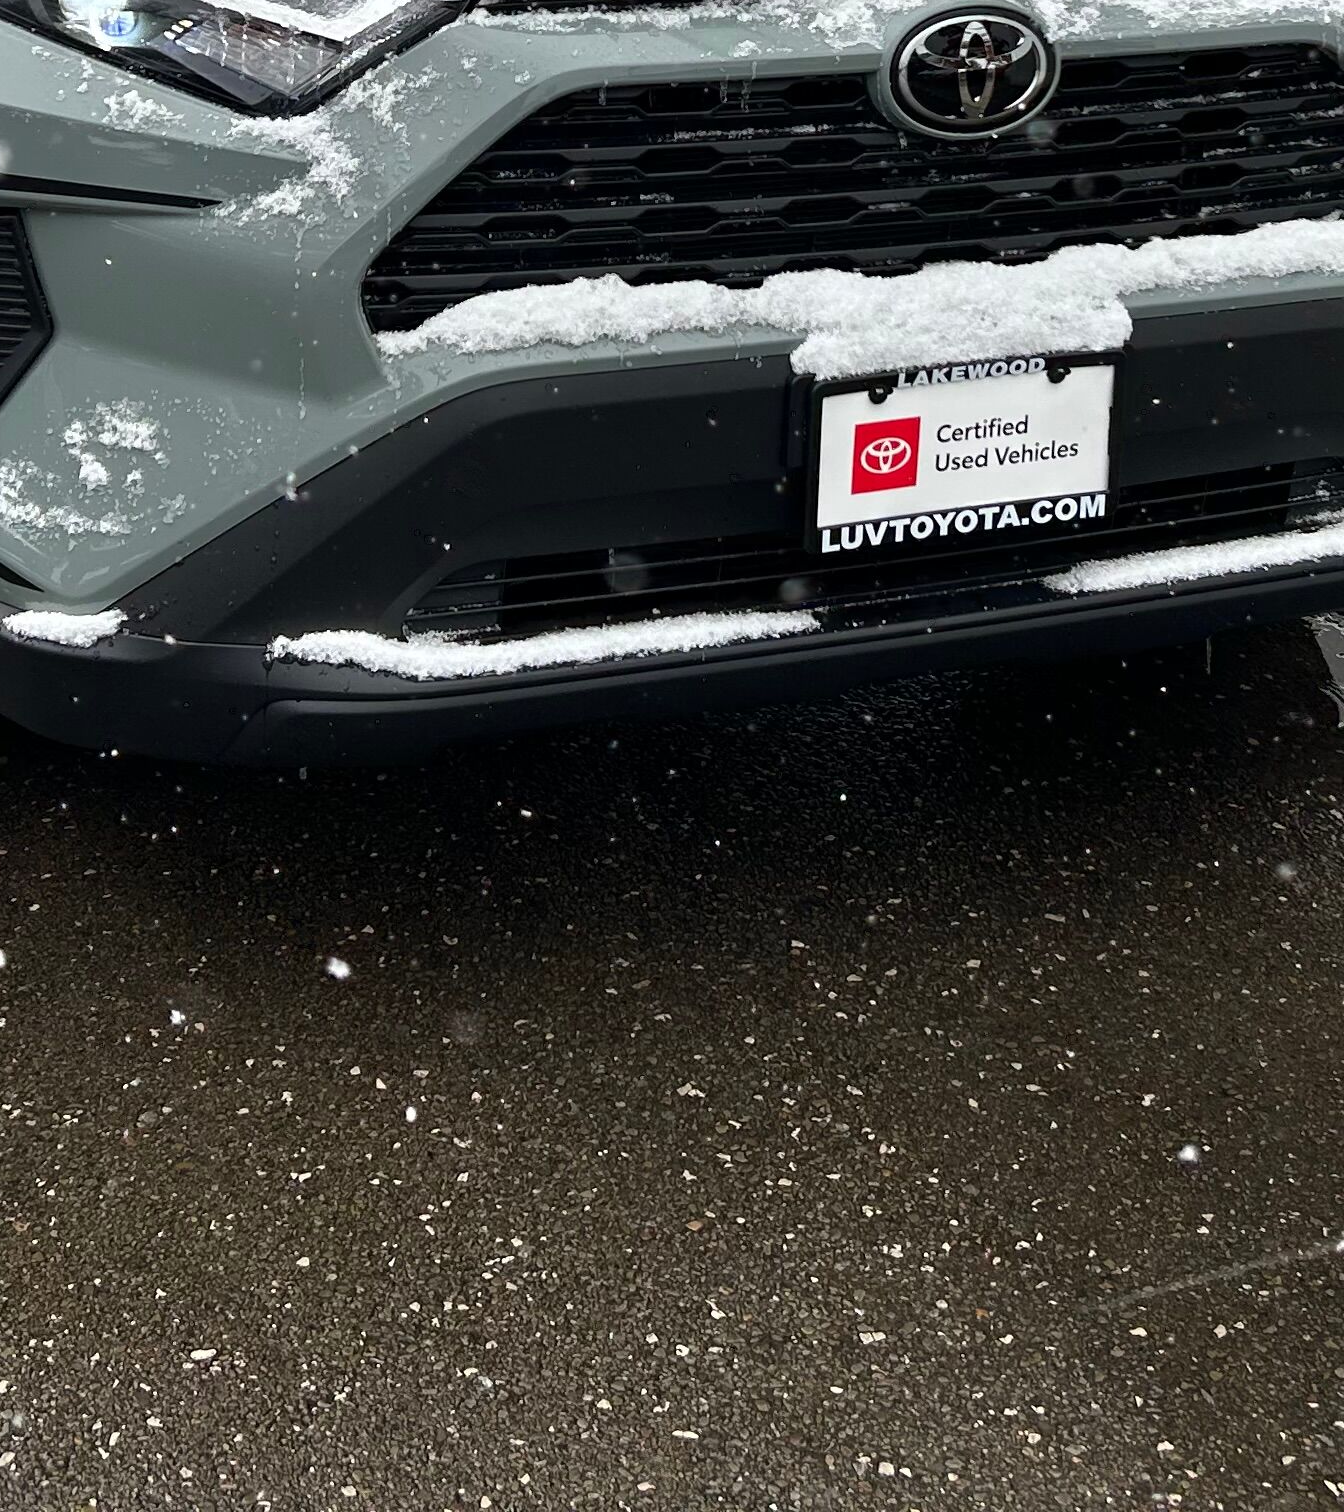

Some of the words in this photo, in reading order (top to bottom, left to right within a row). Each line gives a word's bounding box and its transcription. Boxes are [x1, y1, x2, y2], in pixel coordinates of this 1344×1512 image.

[897, 357, 1046, 388] LAKEWOOD
[936, 415, 1029, 442] Certified
[935, 449, 990, 472] Used
[994, 438, 1079, 464] Vehicles
[821, 493, 1107, 553] LUVTOYOTA.COM
